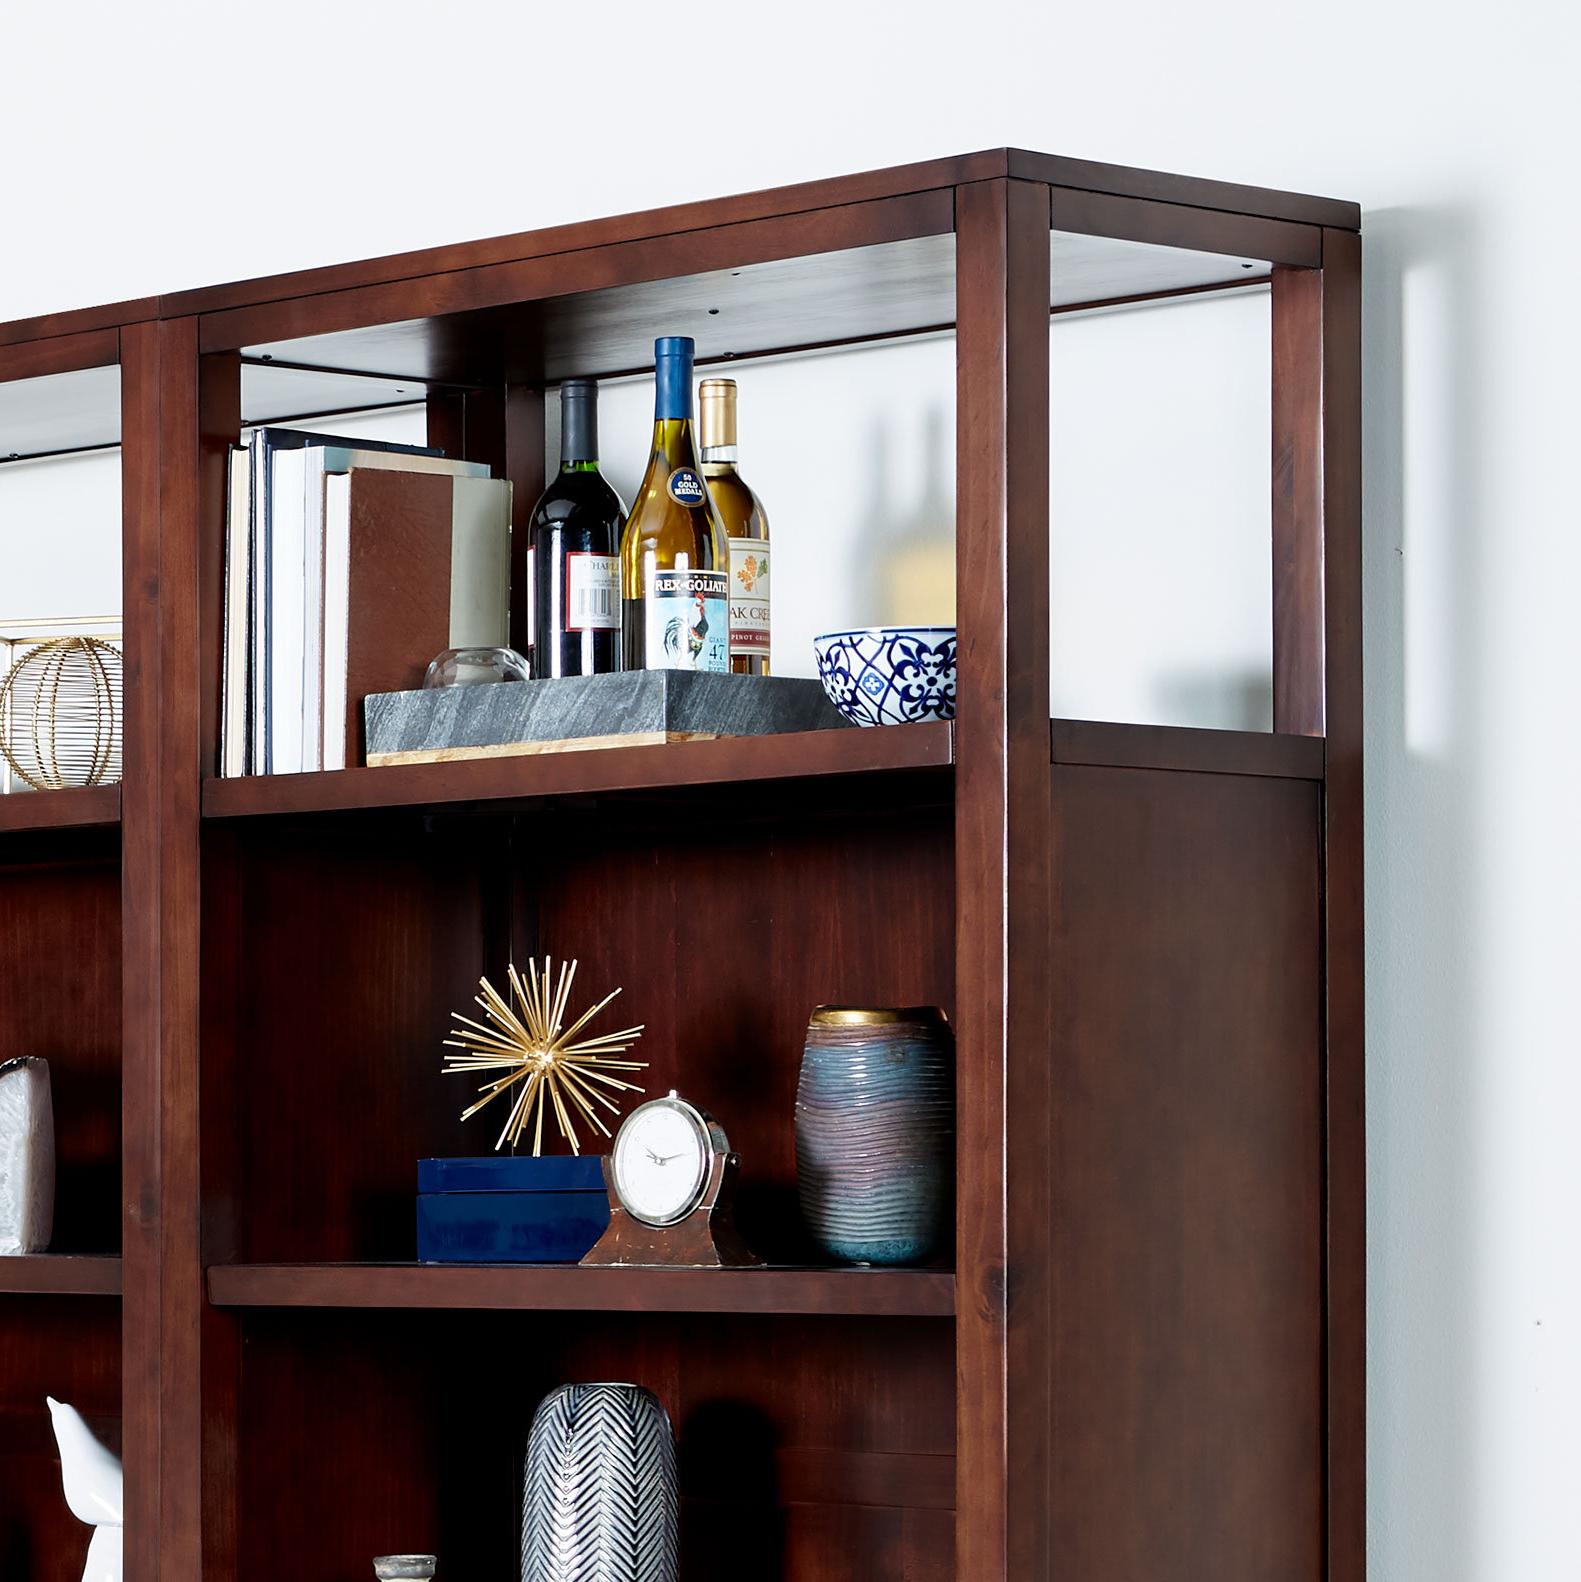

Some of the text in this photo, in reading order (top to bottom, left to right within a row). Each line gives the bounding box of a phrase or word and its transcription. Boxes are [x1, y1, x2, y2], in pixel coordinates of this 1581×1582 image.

[678, 481, 698, 489] GOLD
[655, 579, 681, 592] REX
[730, 606, 747, 619] AK
[709, 644, 725, 660] 47
